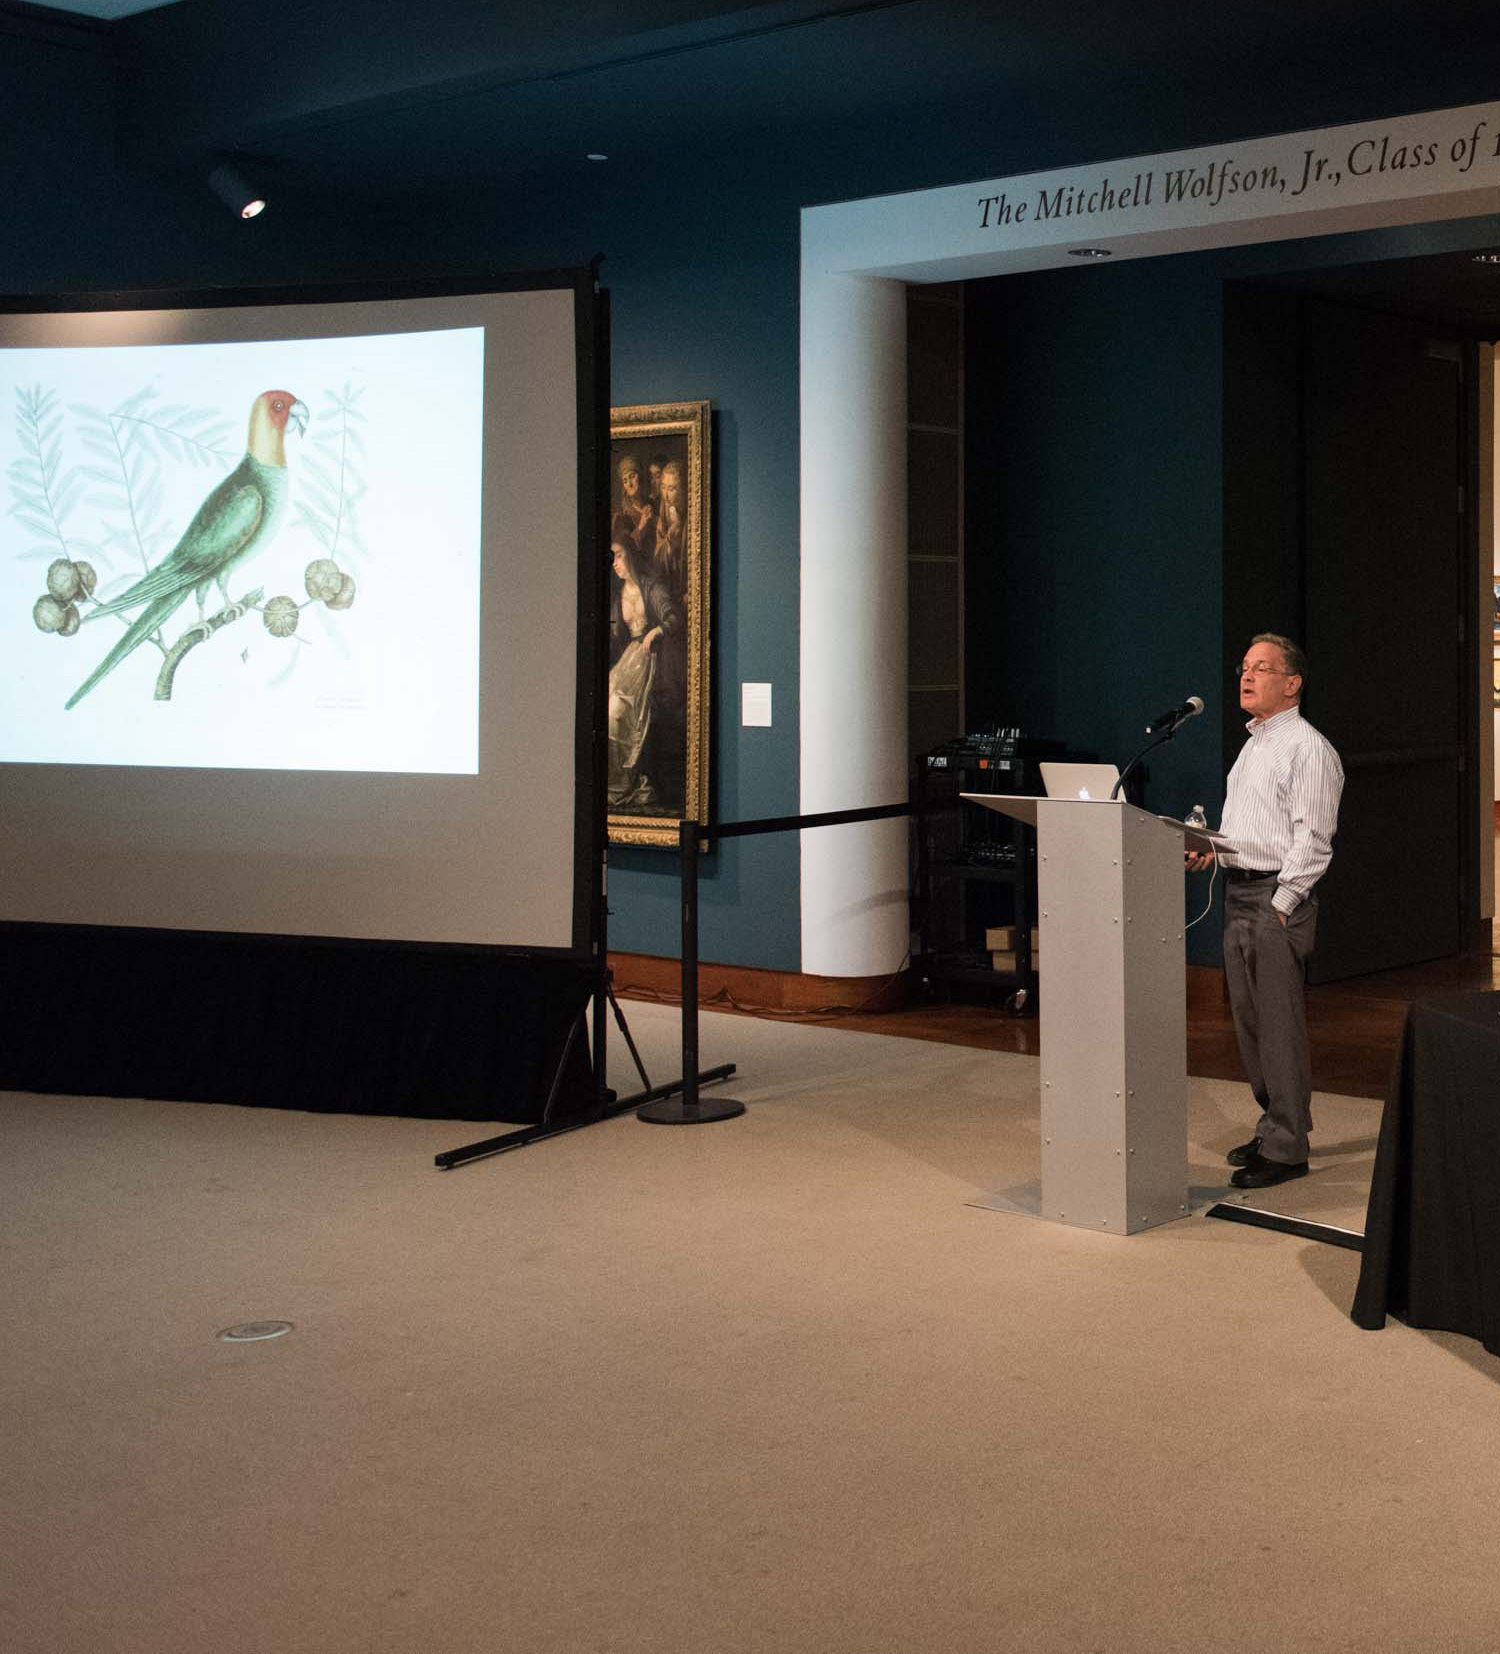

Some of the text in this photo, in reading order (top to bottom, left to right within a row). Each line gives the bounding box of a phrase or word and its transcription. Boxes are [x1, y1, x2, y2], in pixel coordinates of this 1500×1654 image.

[977, 192, 1028, 230] The
[1033, 171, 1154, 222] Mitchell
[1163, 158, 1287, 208] Wolfson,
[1290, 148, 1342, 197] Jr.,
[1346, 135, 1439, 177] Class
[1449, 121, 1488, 173] of
